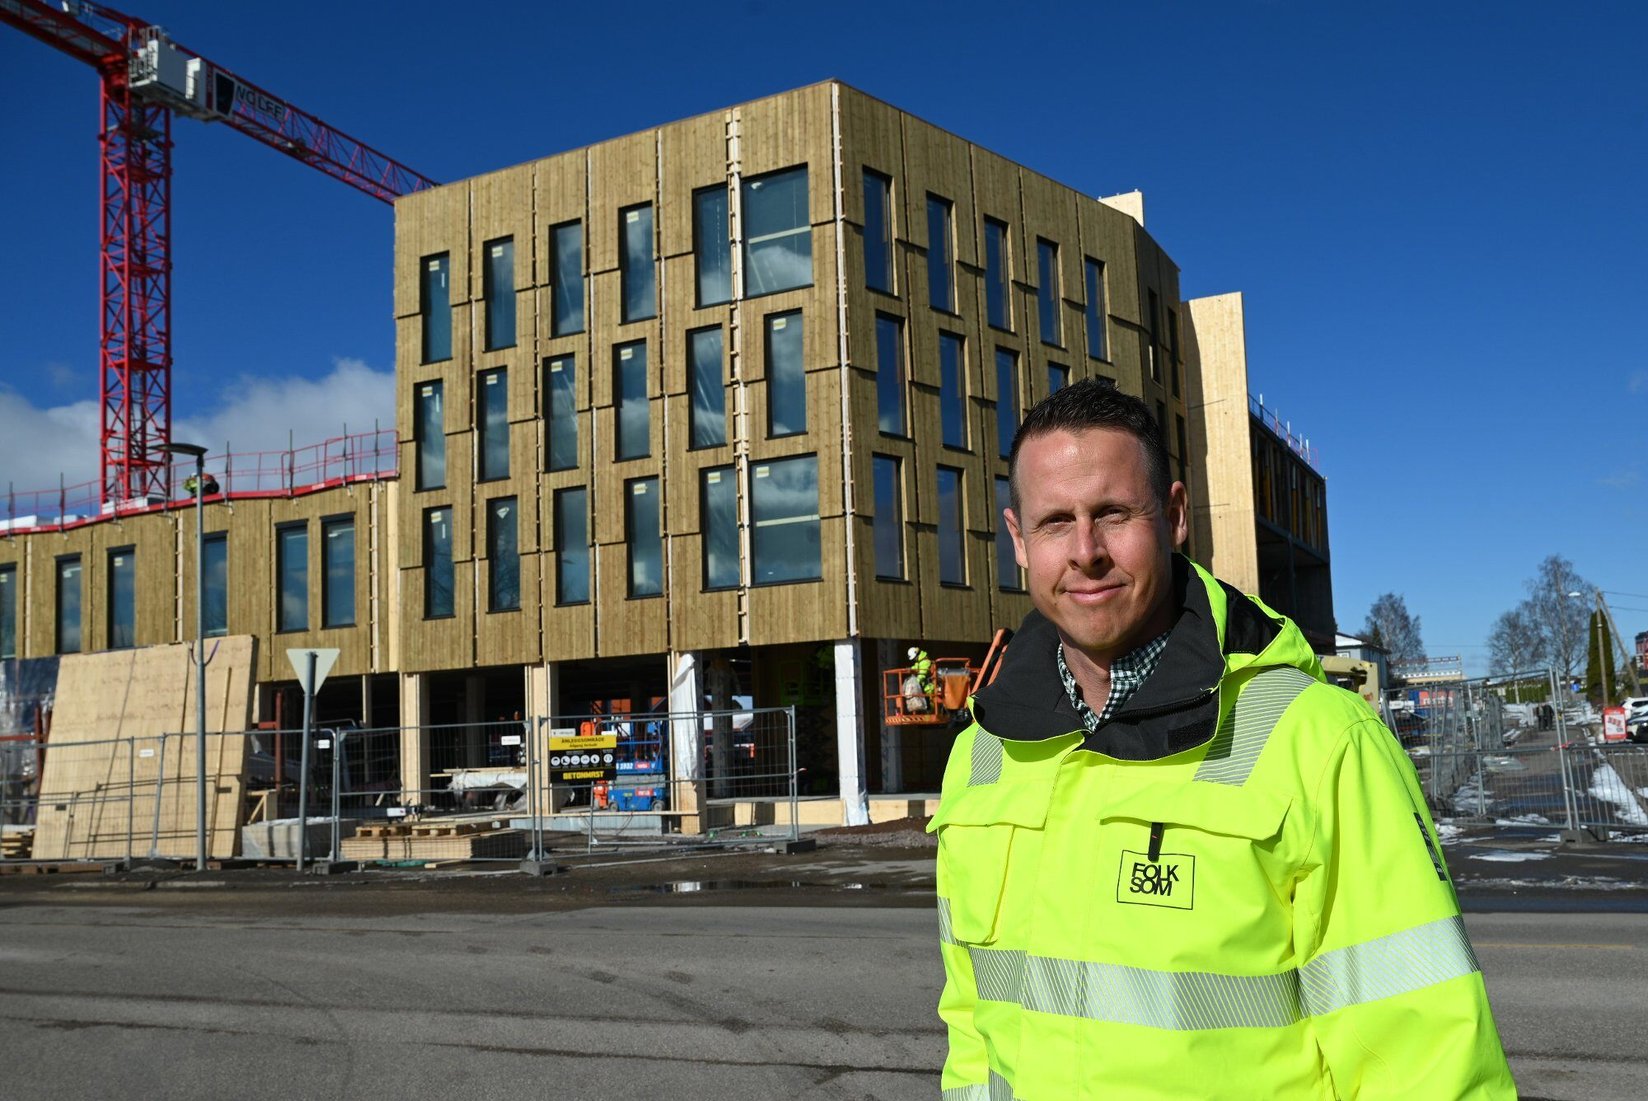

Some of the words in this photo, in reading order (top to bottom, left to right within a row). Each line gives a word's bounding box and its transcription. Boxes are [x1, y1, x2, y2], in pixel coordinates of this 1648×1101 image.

[562, 770, 604, 780] BETONMAST
[1131, 862, 1179, 882] FOLK
[1129, 877, 1173, 896] SOM
